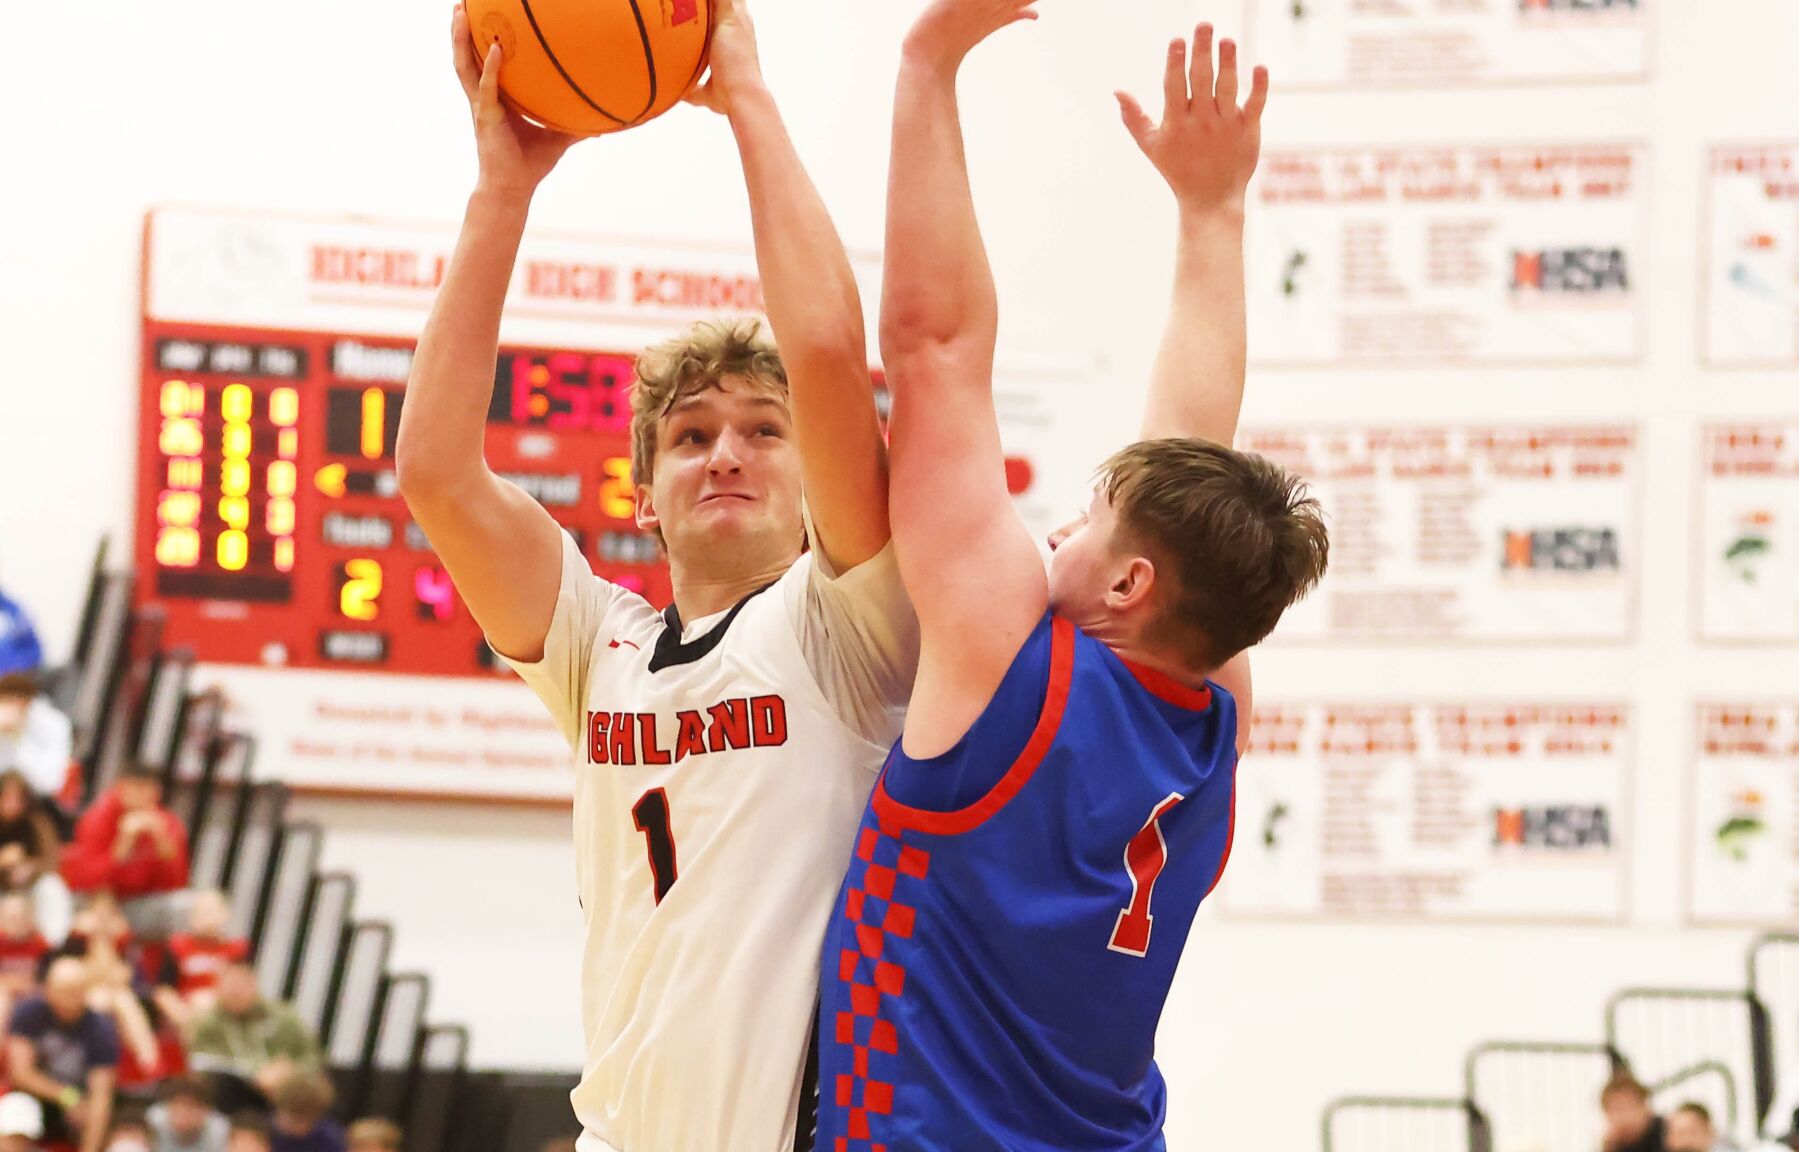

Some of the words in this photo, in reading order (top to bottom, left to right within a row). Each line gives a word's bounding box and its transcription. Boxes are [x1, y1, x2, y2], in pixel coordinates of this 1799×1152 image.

[526, 261, 615, 302] HIGH
[633, 267, 763, 309] SCHOO
[362, 387, 384, 459] 1
[341, 558, 383, 621] 2
[588, 694, 788, 765] IGHLAND
[631, 786, 678, 907] 1
[1107, 791, 1184, 958] 1
